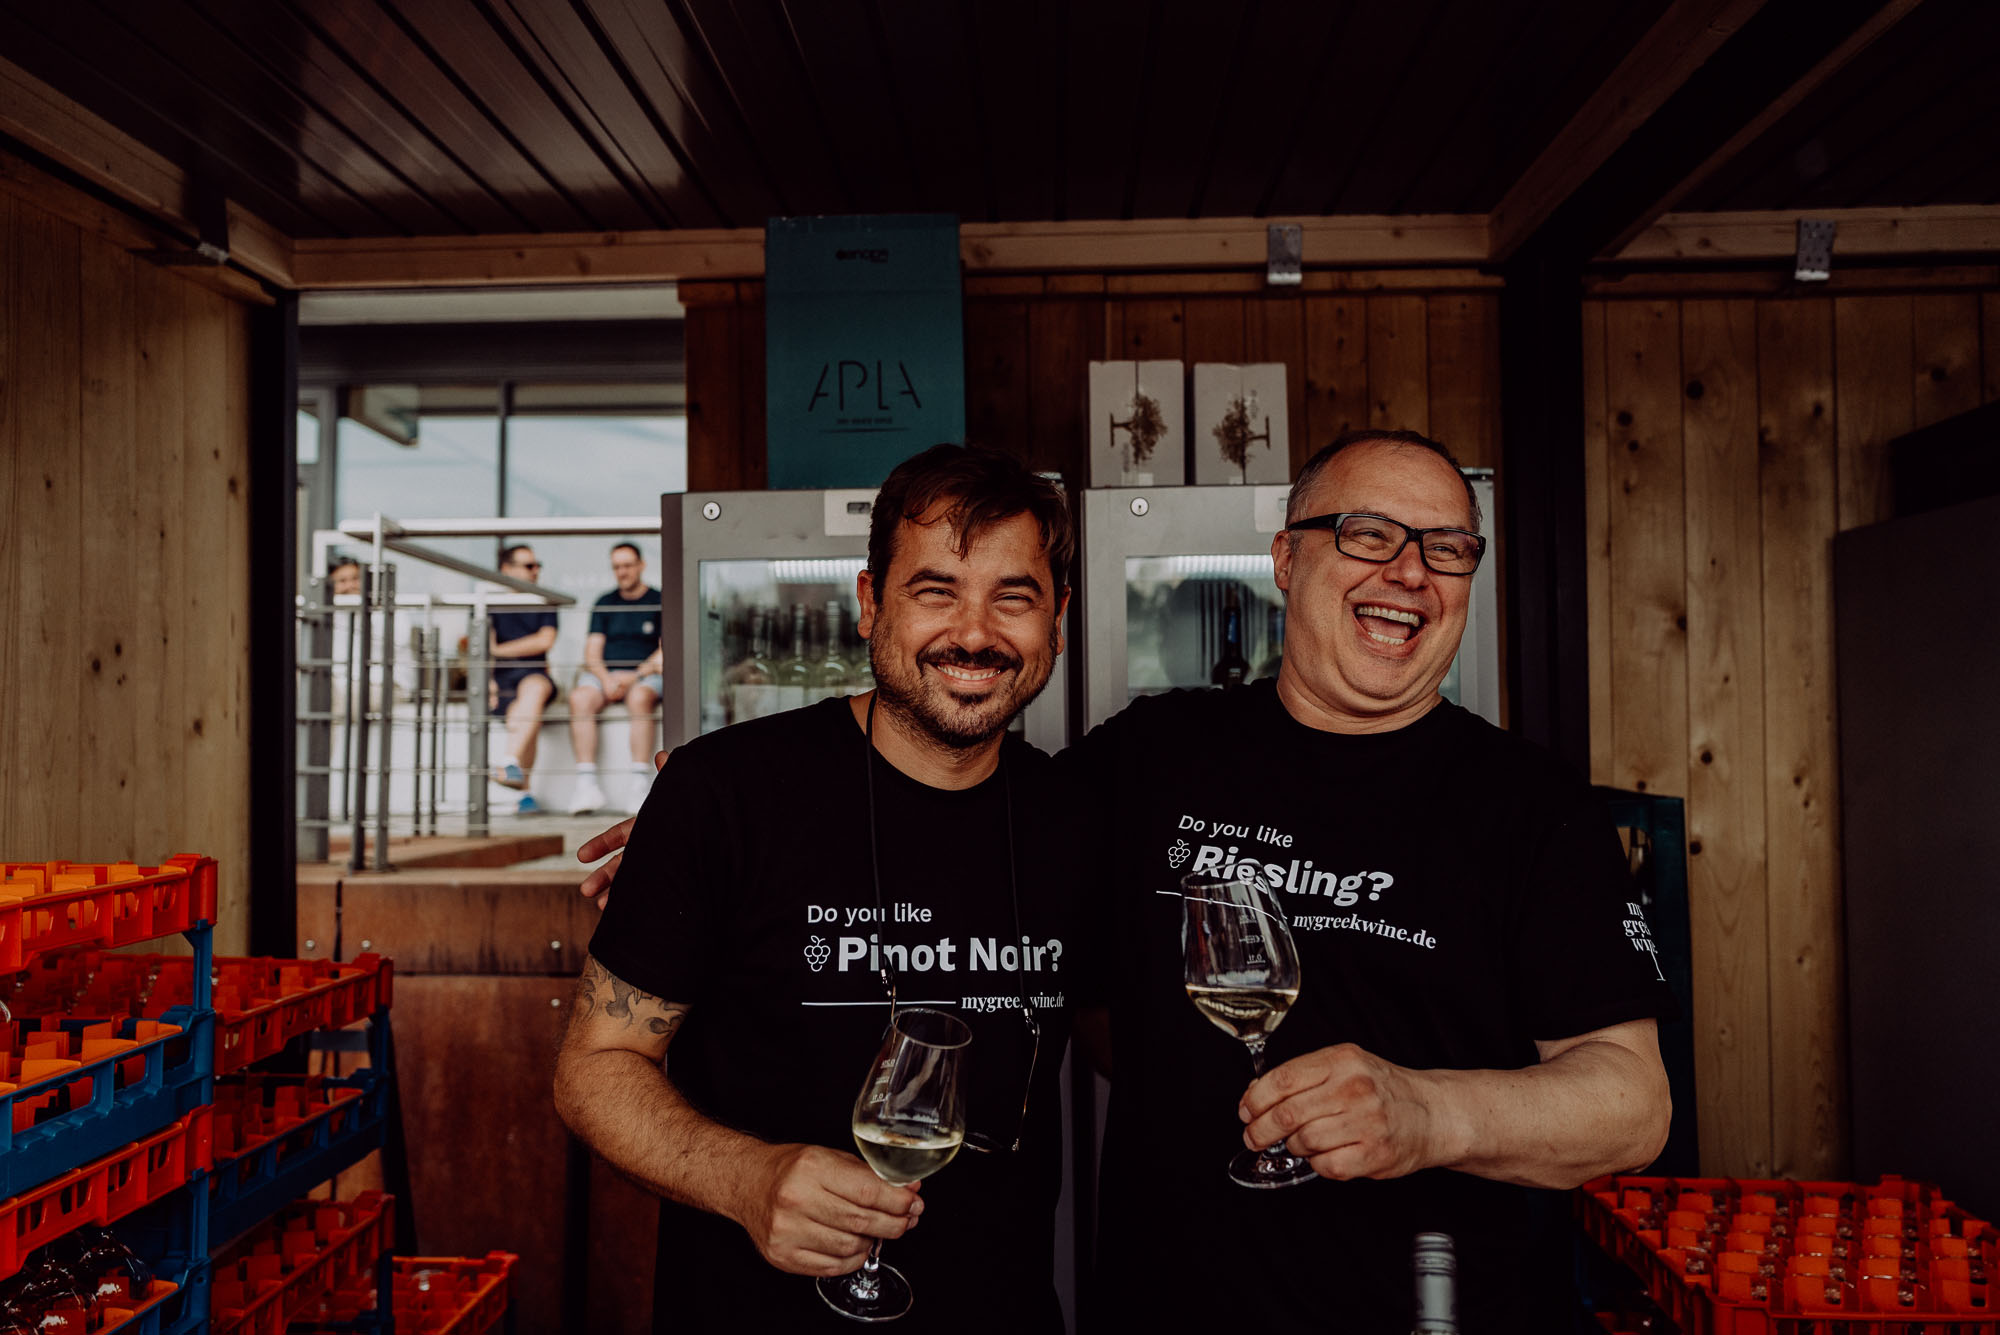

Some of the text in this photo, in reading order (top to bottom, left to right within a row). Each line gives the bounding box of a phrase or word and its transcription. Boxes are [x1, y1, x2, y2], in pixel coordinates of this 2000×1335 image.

[808, 360, 921, 412] APLA
[1178, 814, 1294, 849] Do you like
[1191, 844, 1395, 908] Riesling?
[807, 903, 933, 928] Do you like
[1292, 913, 1437, 950] mygreekwine.de
[837, 933, 1063, 973] Pinot Noir?
[961, 991, 1065, 1013] mygreewine.de
